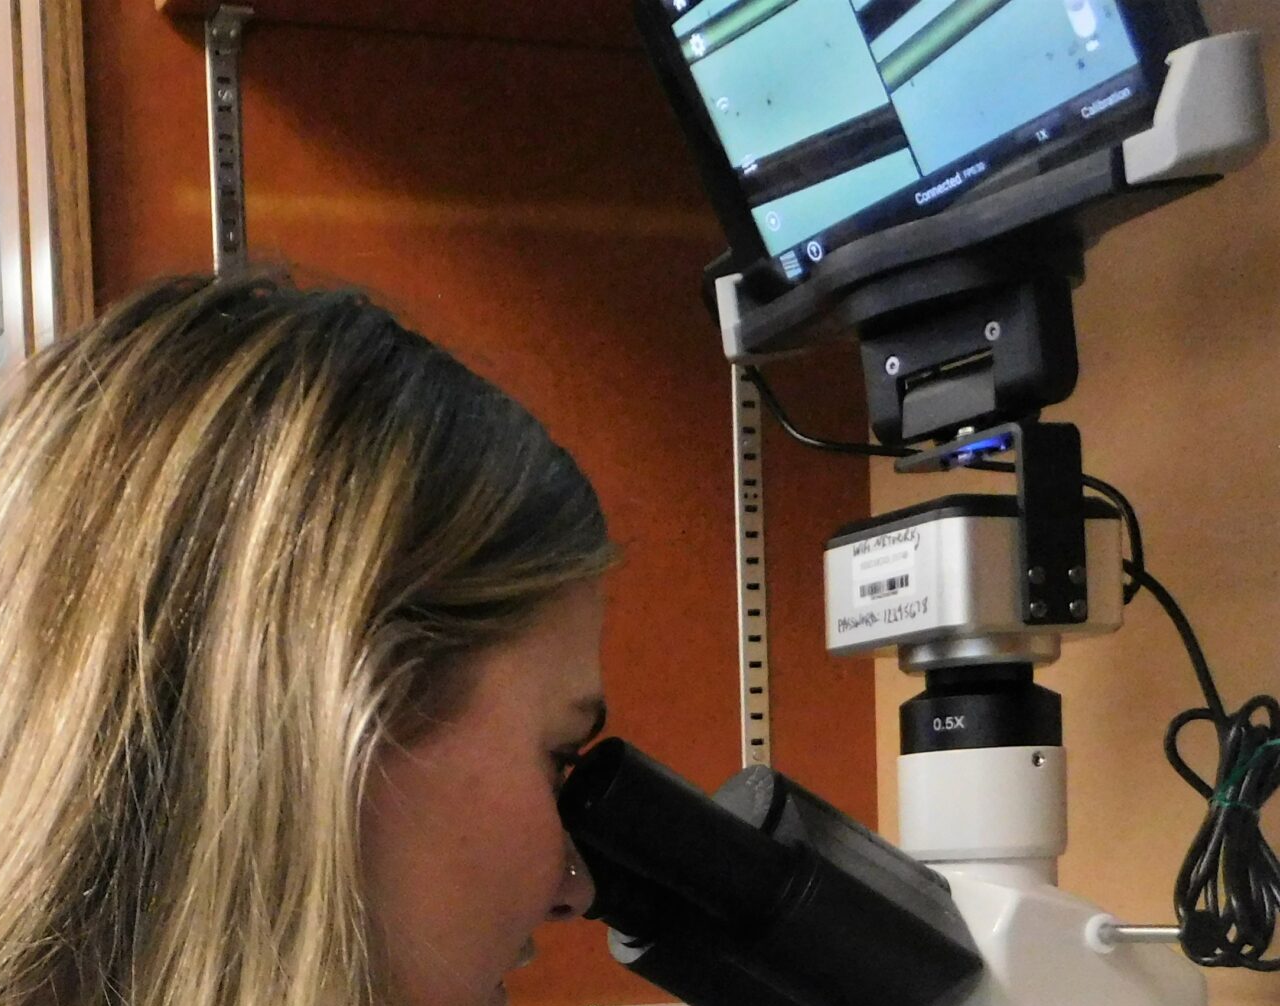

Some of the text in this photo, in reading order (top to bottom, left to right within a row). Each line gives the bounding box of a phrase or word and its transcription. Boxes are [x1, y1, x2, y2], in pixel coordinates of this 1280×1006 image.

[1081, 87, 1131, 118] Calibration
[915, 172, 962, 205] Connected
[933, 716, 965, 731] 0.5X
